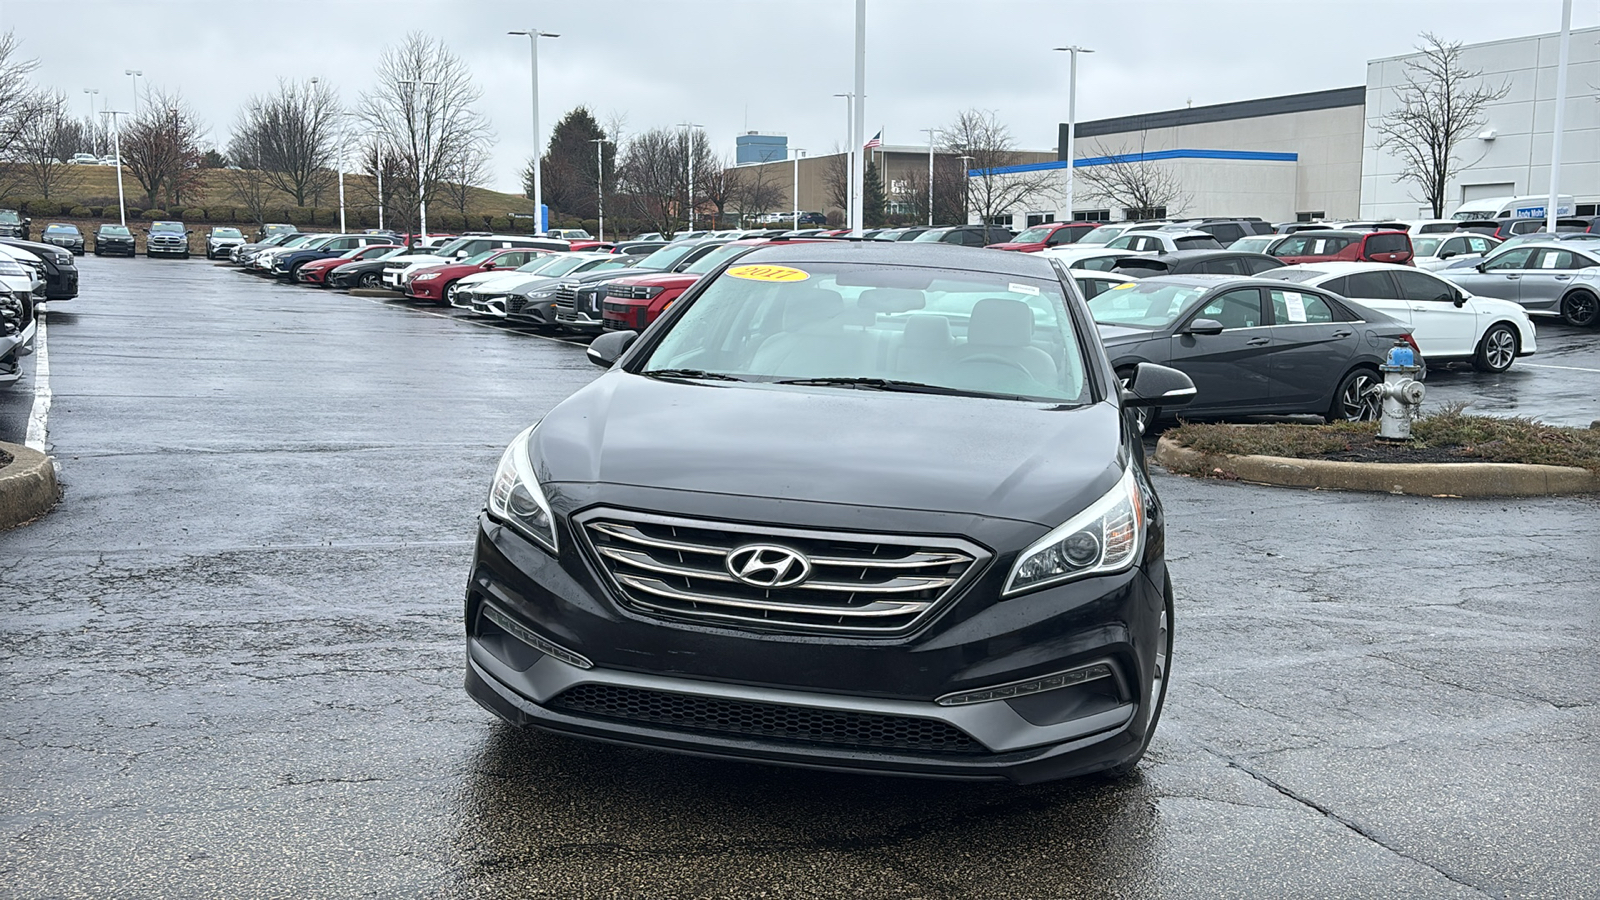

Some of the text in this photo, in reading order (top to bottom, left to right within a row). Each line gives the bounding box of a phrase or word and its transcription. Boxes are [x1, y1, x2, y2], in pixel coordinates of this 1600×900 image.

[1518, 210, 1531, 218] Andy
[1531, 208, 1544, 217] Mohr
[735, 267, 799, 279] 2017
